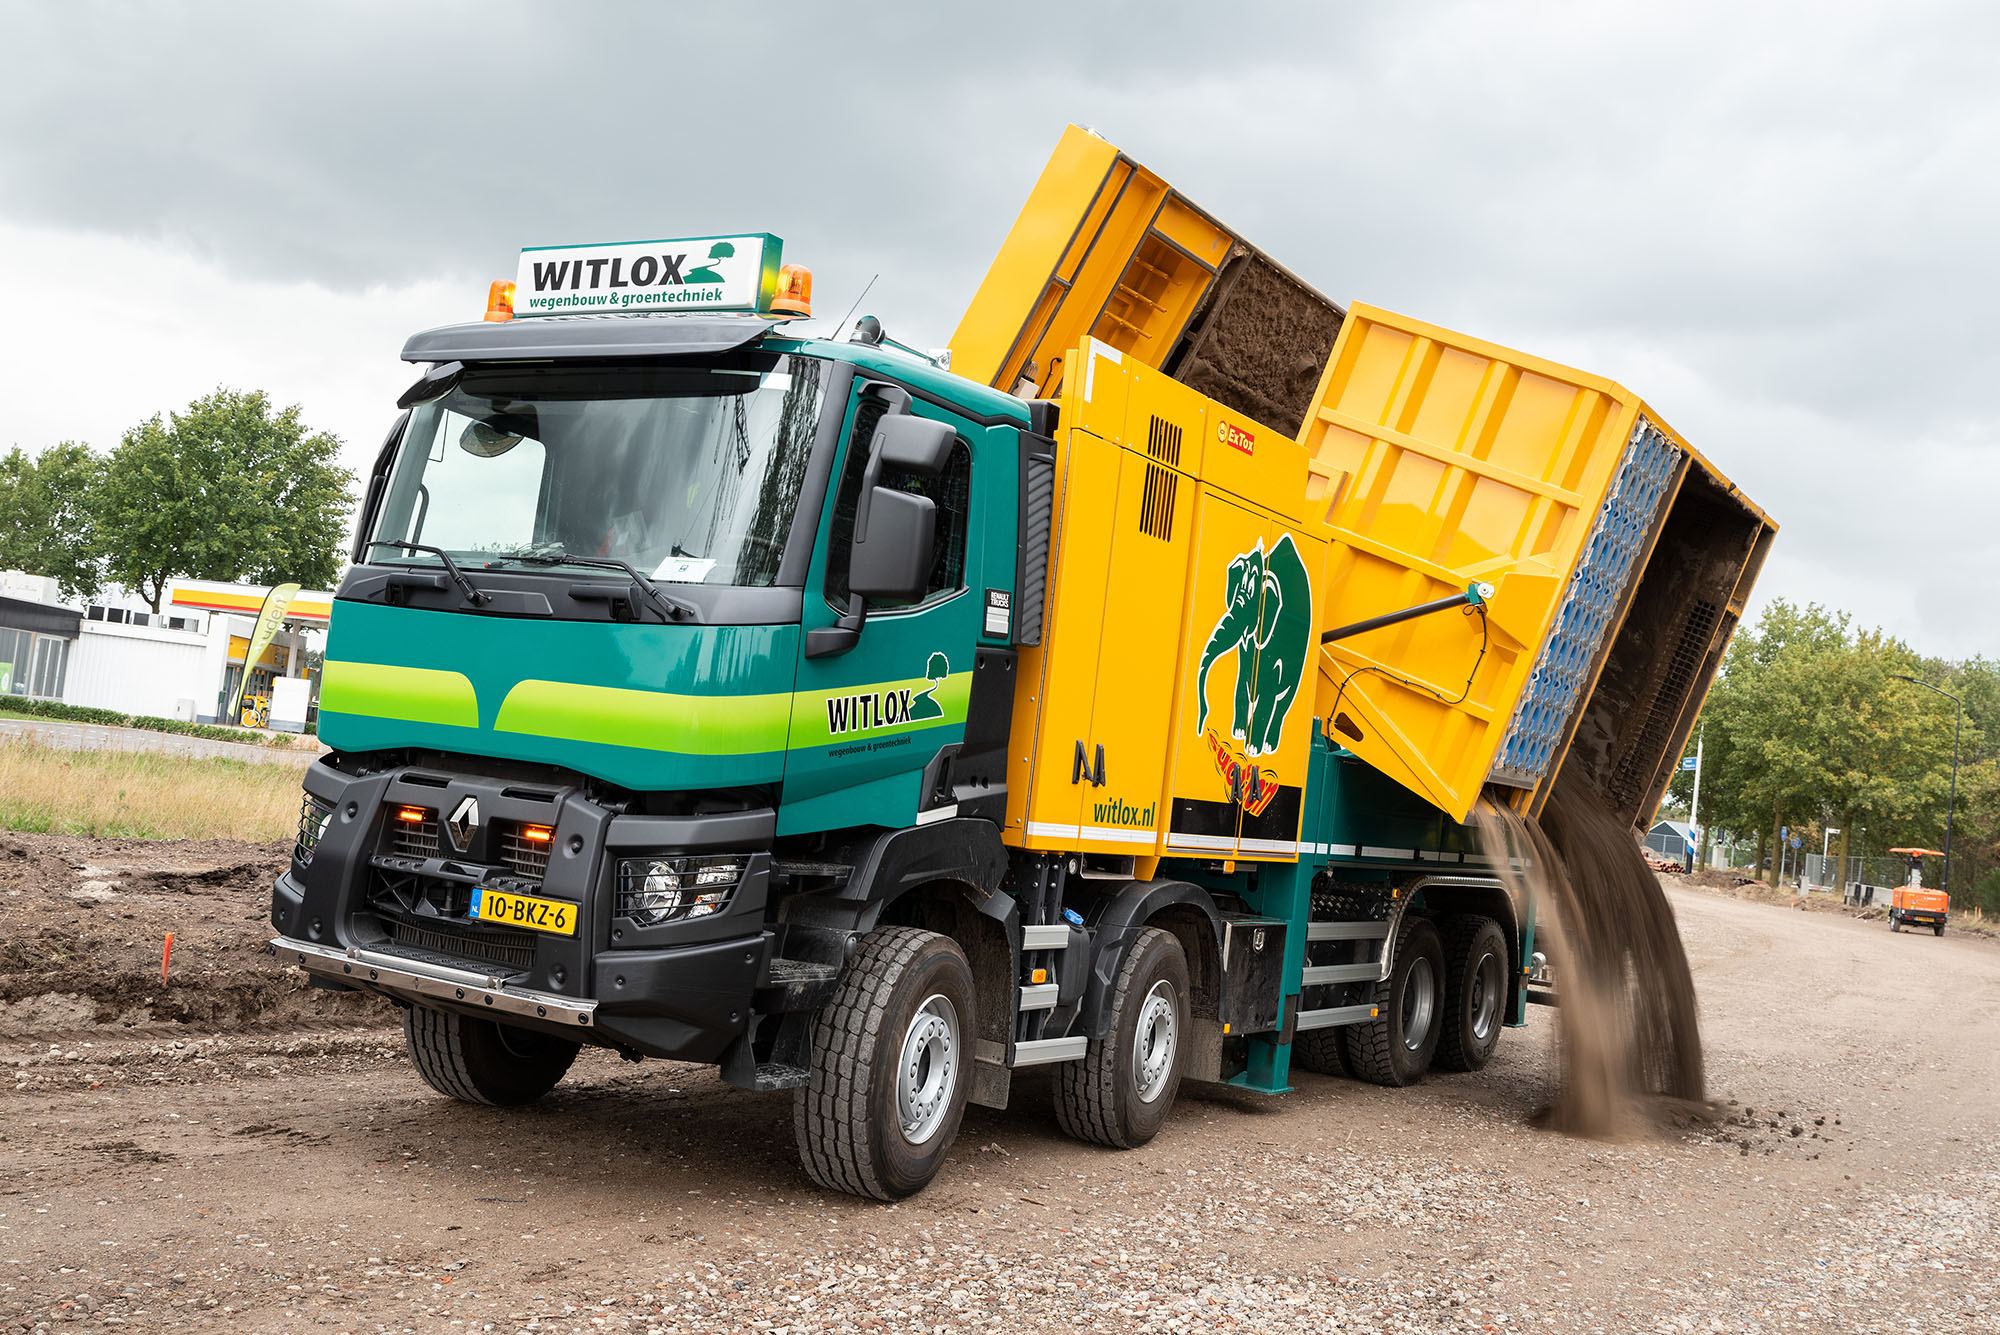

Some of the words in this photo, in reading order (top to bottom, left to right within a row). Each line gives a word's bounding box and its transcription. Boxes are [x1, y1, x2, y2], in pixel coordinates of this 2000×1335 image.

[532, 254, 688, 292] WITLOX
[529, 292, 608, 310] wegenbouw
[610, 292, 619, 305] &
[621, 288, 723, 308] groentechniek
[1228, 427, 1254, 452] ExTox
[826, 689, 911, 734] WITLOX
[828, 742, 866, 758] wegenbouw
[867, 742, 872, 751] &
[873, 736, 912, 753] groentechniek
[1093, 797, 1156, 827] witlox.nl
[471, 905, 479, 913] NL
[488, 896, 566, 929] 10-BKZ-6
